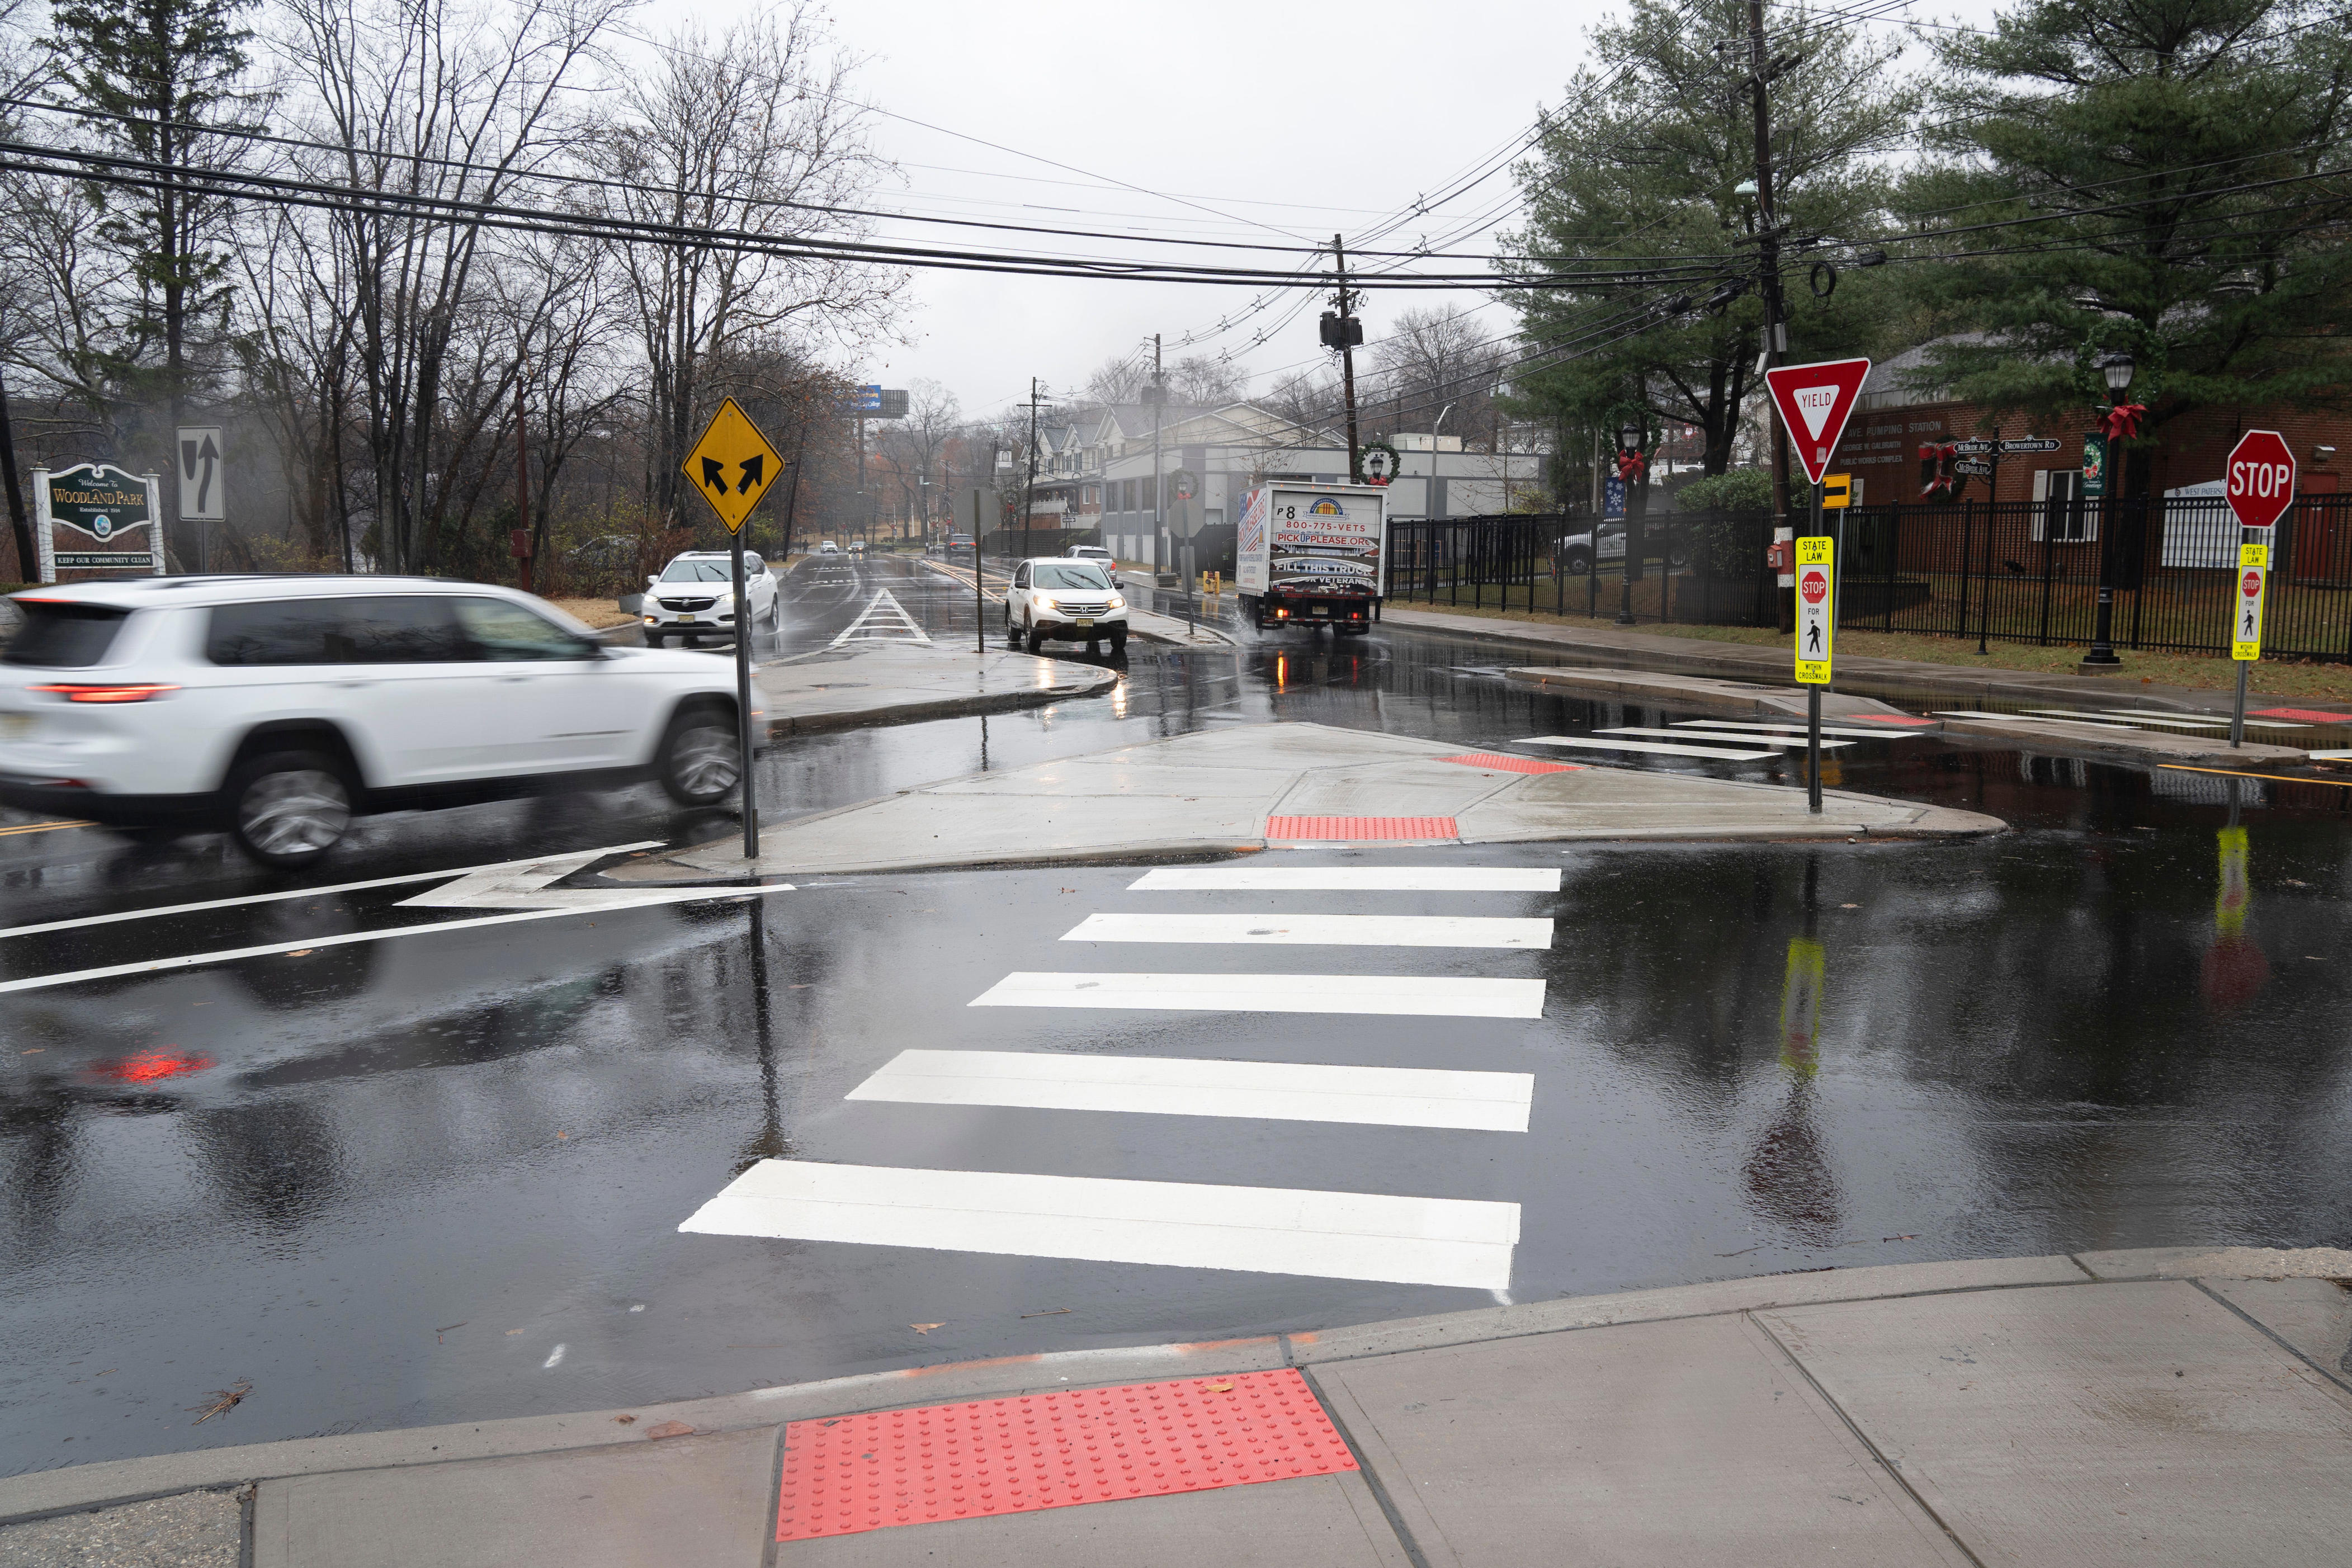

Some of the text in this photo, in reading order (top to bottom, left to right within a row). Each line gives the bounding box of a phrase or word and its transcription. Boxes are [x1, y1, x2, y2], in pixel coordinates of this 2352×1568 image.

[1802, 393, 1831, 408] YIELD
[1848, 428, 1863, 438] AVE.
[1867, 424, 1902, 436] PUMPING
[1909, 421, 1941, 433] STATION
[1840, 457, 1858, 466] PUBLIC
[1858, 456, 1877, 465] WORKS
[78, 479, 108, 487] Welcome
[2231, 461, 2289, 498] STOP
[1286, 506, 1295, 519] 8
[1286, 521, 1365, 532] 800-775-VETS
[1803, 541, 1826, 550] STATE
[1807, 552, 1822, 561] LAW
[1303, 563, 1329, 573] THIS
[1803, 582, 1825, 594] STOP
[2243, 579, 2260, 590] STOP
[1798, 672, 1827, 681] CROSSWALK
